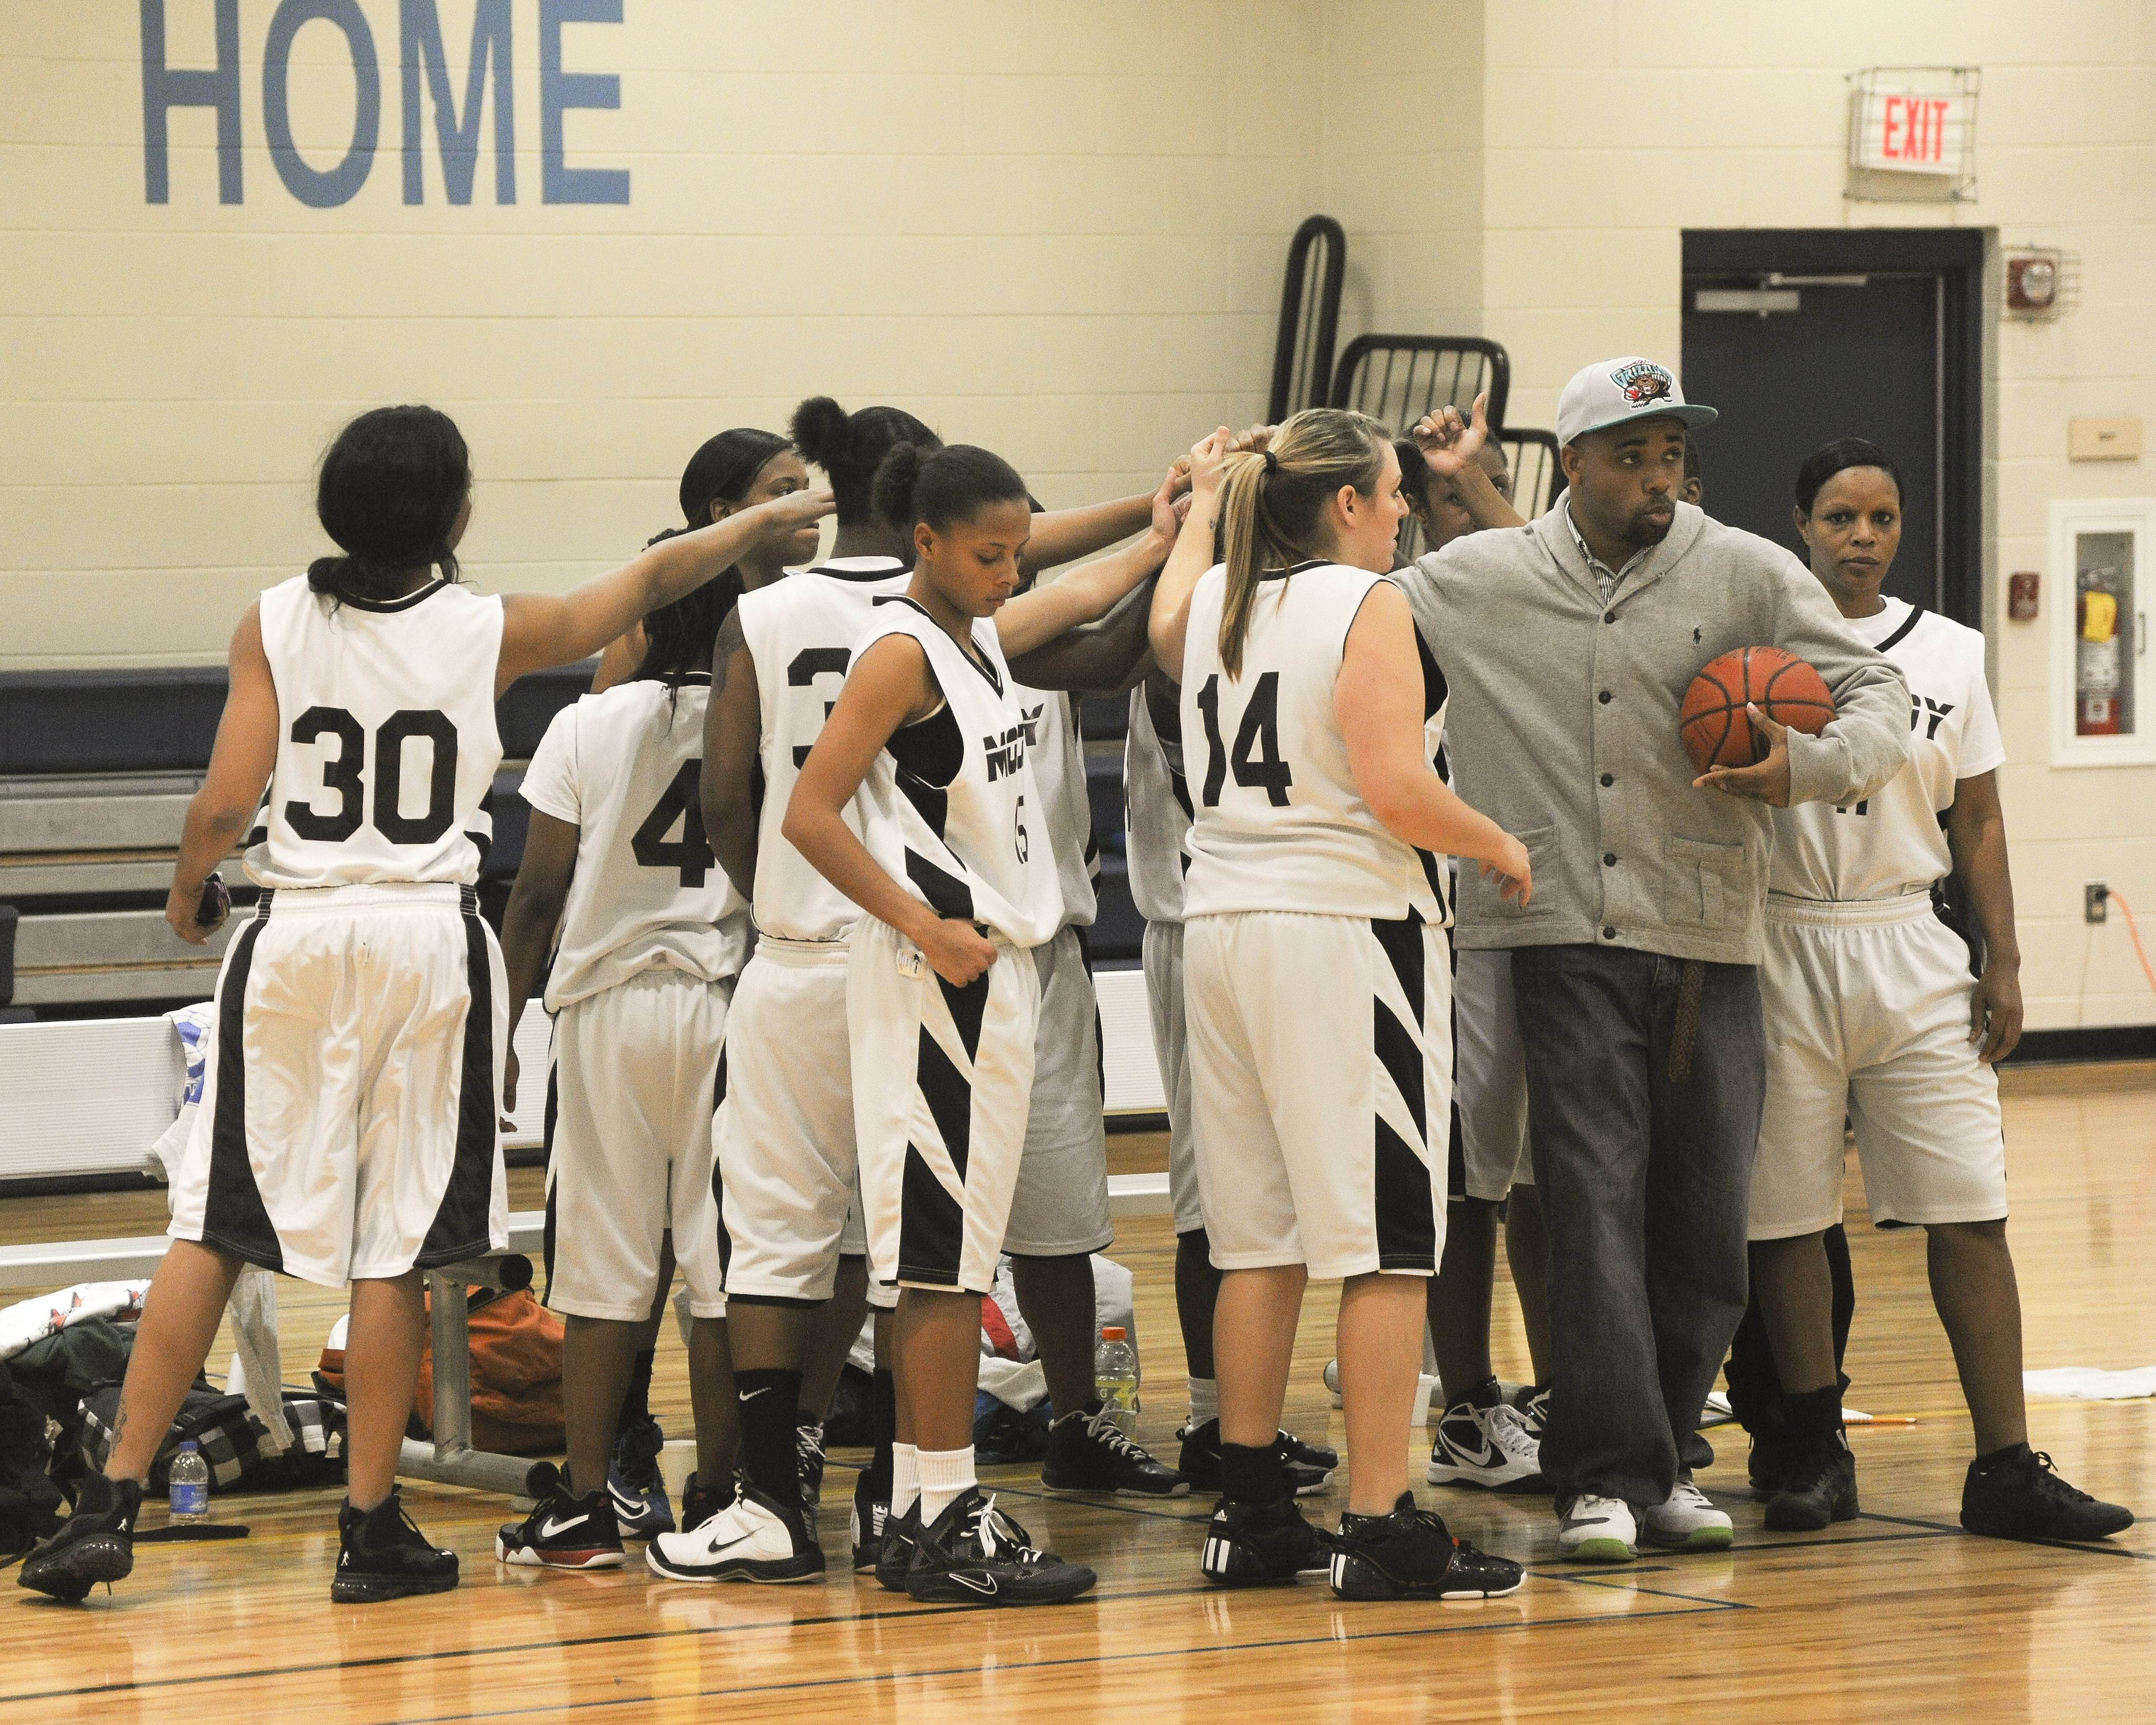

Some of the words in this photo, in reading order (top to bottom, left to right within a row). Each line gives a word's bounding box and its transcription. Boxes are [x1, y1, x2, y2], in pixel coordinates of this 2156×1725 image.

[139, 0, 630, 208] HOME
[1883, 95, 1950, 162] EXIT
[284, 705, 457, 845] 30
[1197, 671, 1293, 807] 14
[631, 758, 715, 888] 4
[873, 1505, 888, 1537] NIKE
